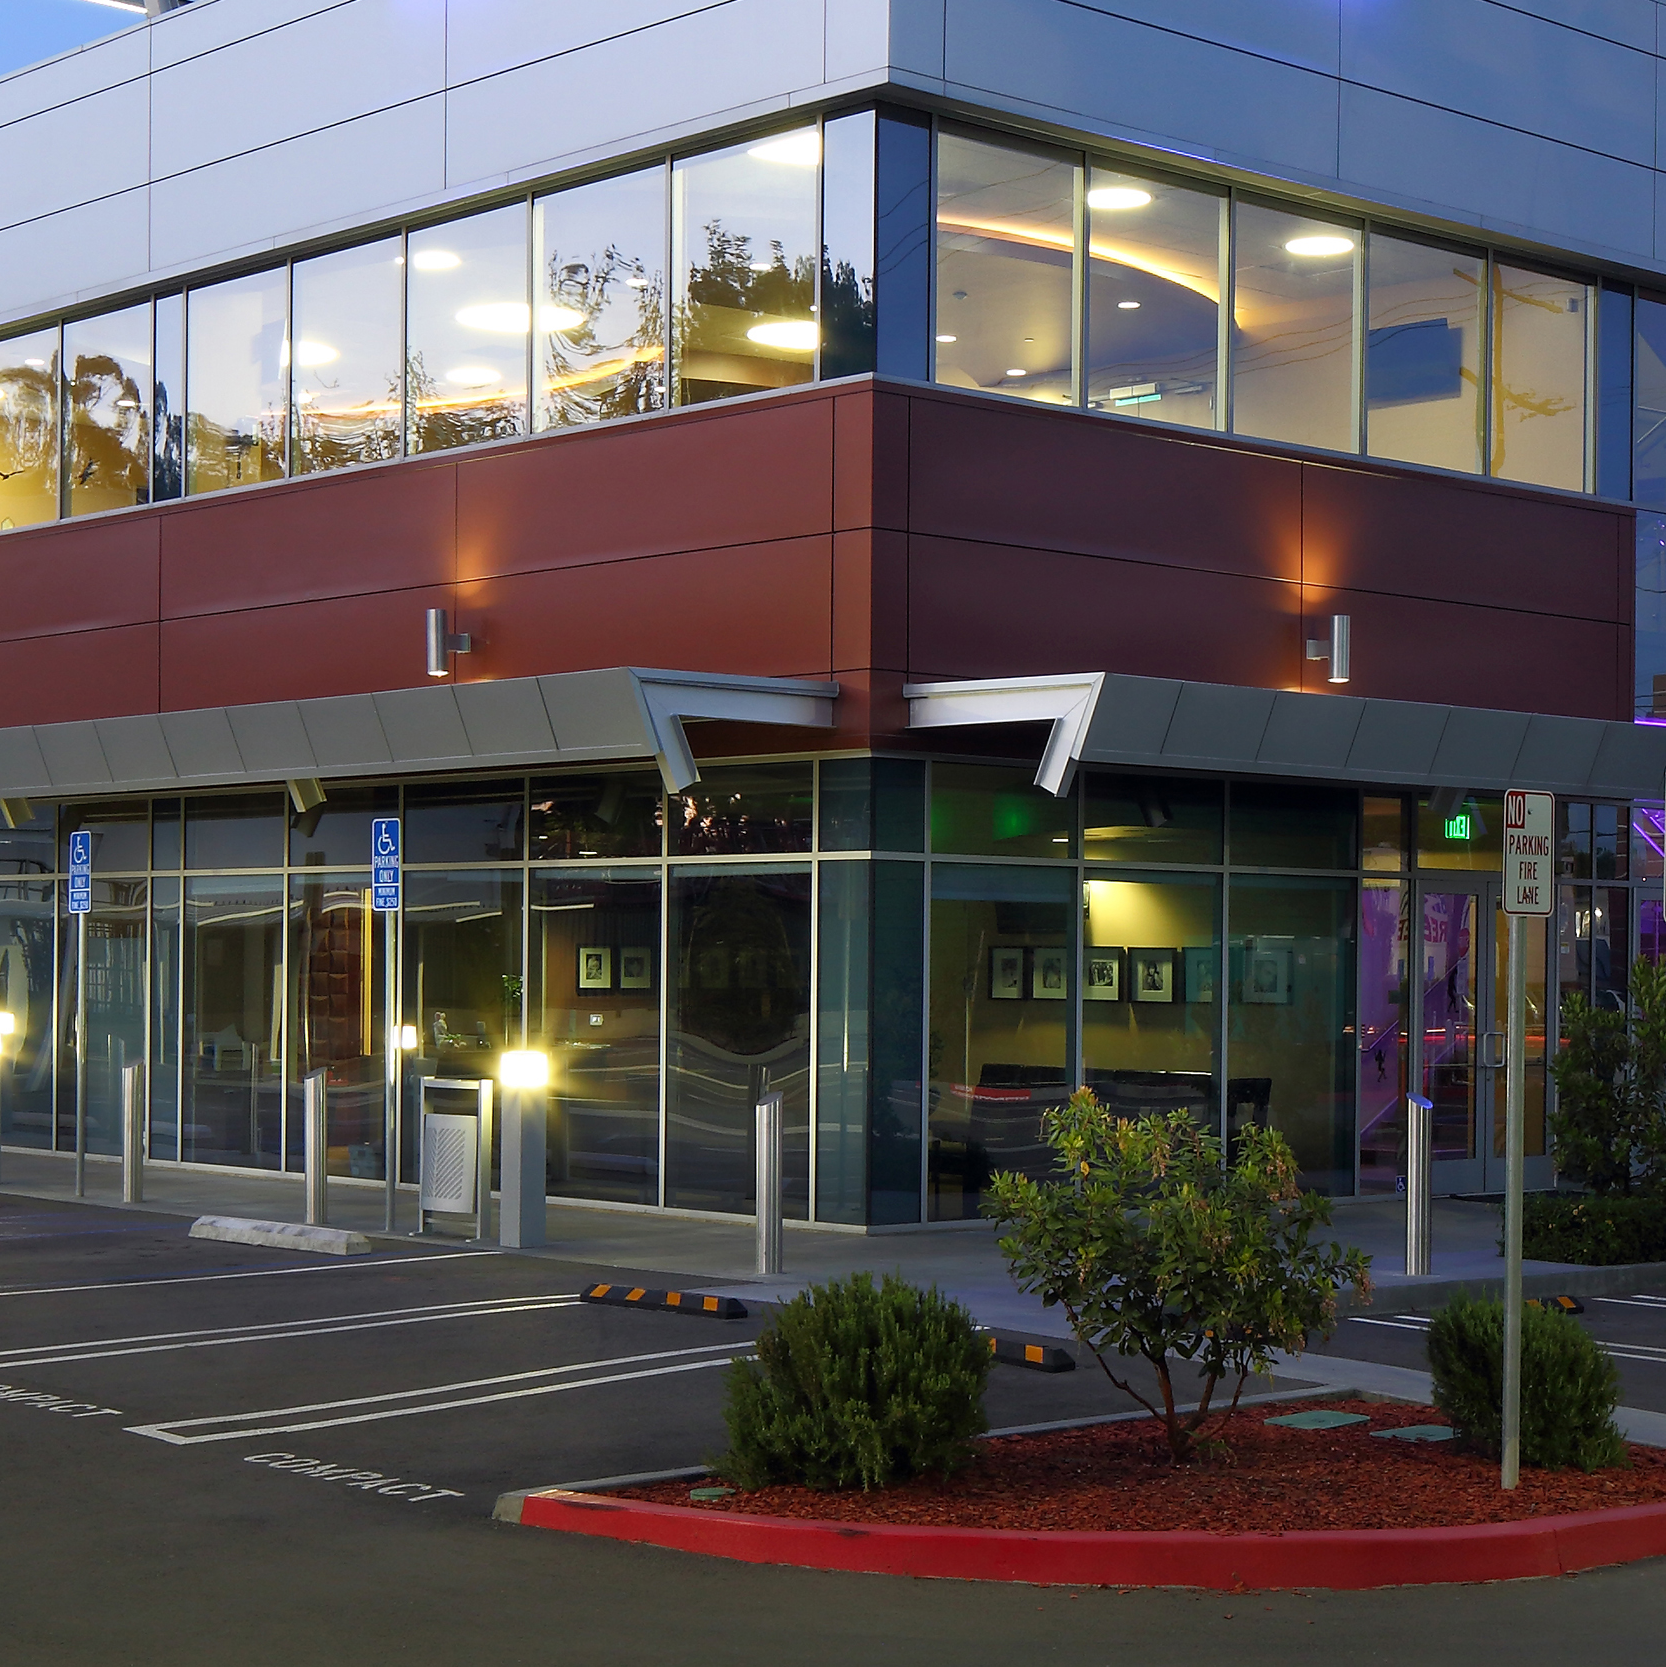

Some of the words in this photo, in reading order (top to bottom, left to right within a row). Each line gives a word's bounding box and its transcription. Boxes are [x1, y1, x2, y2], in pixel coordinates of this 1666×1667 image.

[1508, 795, 1524, 825] NO
[1509, 834, 1549, 857] PARKING
[374, 855, 399, 868] PARKING
[1519, 861, 1538, 880] FIRE
[379, 869, 394, 882] ONLY
[1517, 886, 1539, 904] LANE
[243, 1452, 465, 1502] COMPACT
